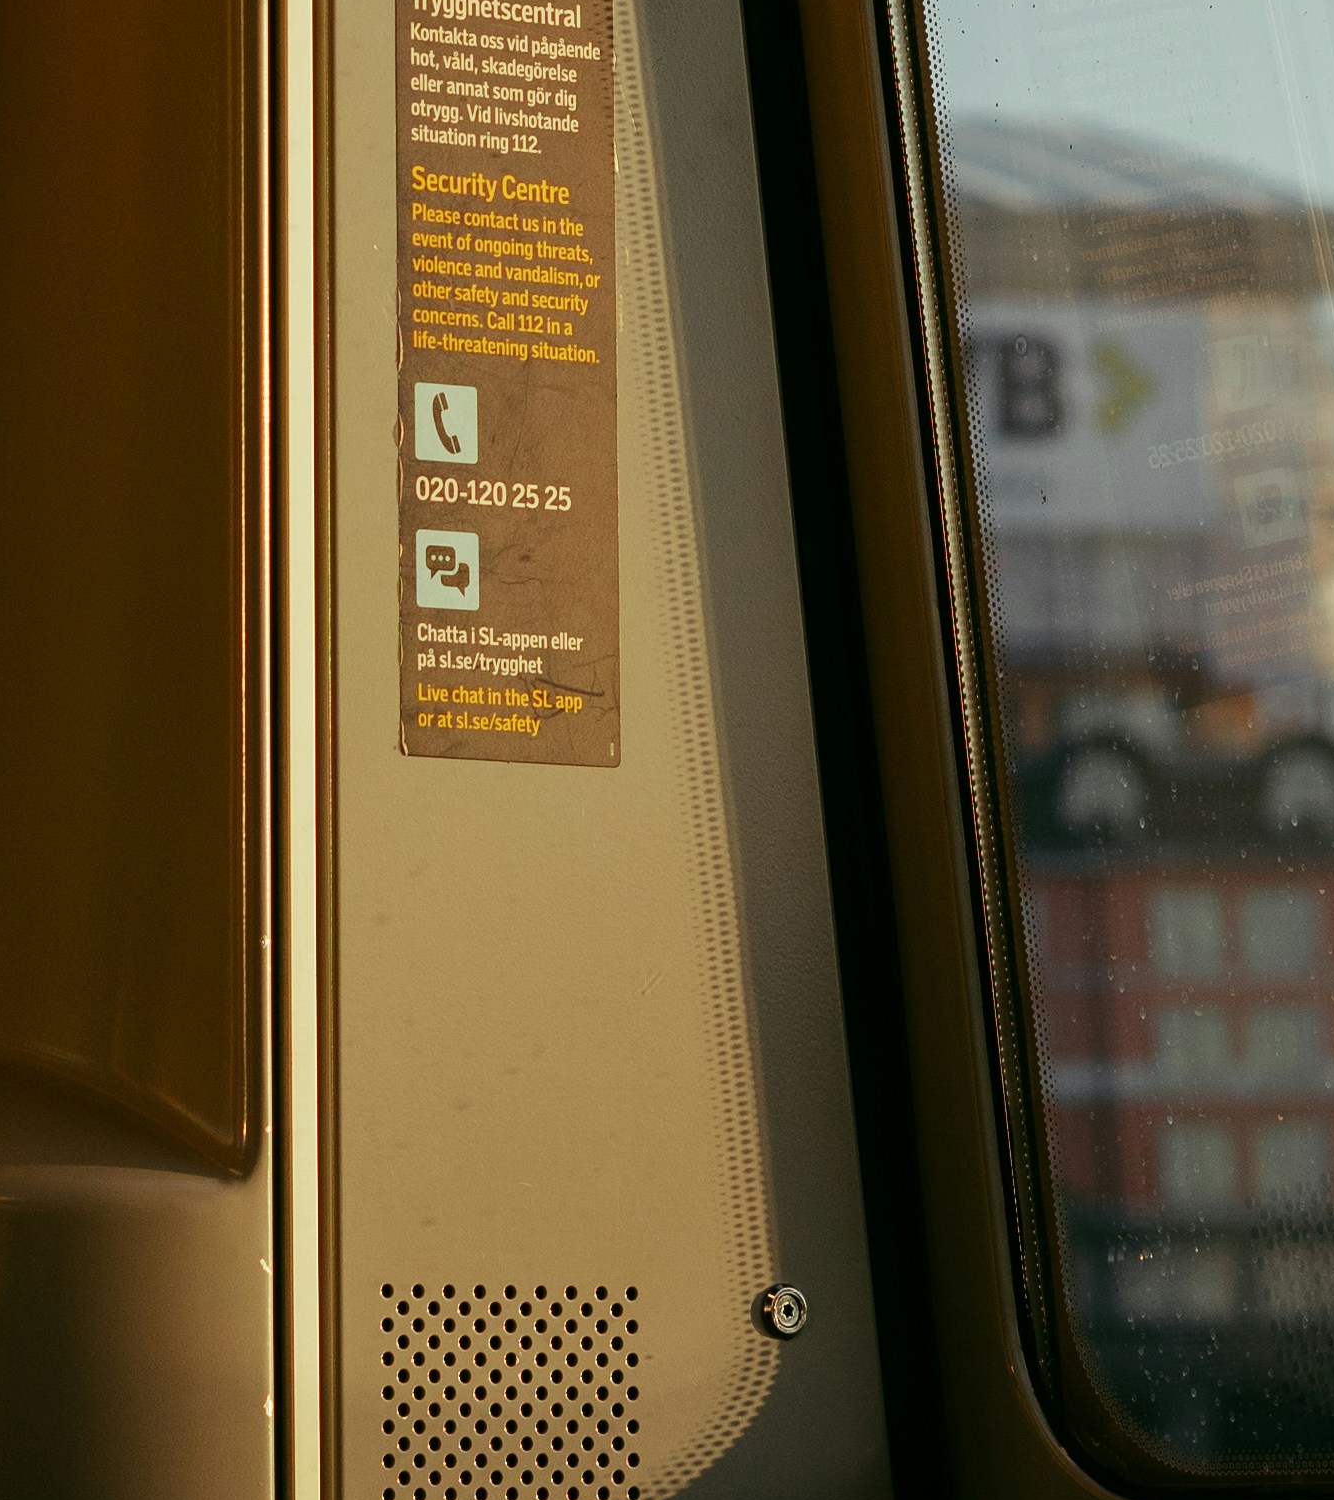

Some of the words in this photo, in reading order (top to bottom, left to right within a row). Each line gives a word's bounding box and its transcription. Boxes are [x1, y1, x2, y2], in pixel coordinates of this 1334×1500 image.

[409, 21, 478, 48] Kontakta
[479, 34, 505, 51] oss
[506, 34, 529, 53] vid
[531, 35, 602, 61] pågående
[410, 46, 440, 71] hot,
[442, 50, 479, 76] våld,
[481, 55, 578, 84] skadegörelse
[410, 72, 444, 94] eller
[445, 80, 490, 99] annat
[492, 85, 524, 103] som
[526, 86, 553, 108] gör
[554, 88, 578, 112] dig
[410, 98, 464, 125] otrygg.
[466, 103, 492, 124] Vid
[494, 106, 580, 134] livshotande
[410, 123, 477, 148] situation
[479, 131, 510, 155] ring
[511, 133, 543, 155] 112.
[411, 164, 498, 203] Security
[501, 174, 570, 206] Centre
[411, 201, 461, 226] Please
[463, 210, 520, 231] contact
[521, 217, 540, 233] us
[542, 215, 557, 234] in
[558, 216, 585, 237] the
[411, 231, 454, 250] event
[456, 232, 472, 252] of
[474, 237, 534, 261] ongoing
[535, 240, 594, 266] threats,
[411, 254, 472, 277] violence
[474, 261, 503, 280] and
[504, 265, 584, 290] vandalism,
[584, 273, 602, 289] or
[412, 279, 453, 301] other
[454, 283, 500, 309] safety
[501, 288, 529, 307] and
[531, 293, 589, 317] security
[412, 308, 484, 329] concerns.
[486, 310, 515, 331] Call
[517, 313, 545, 334] 112
[546, 316, 561, 336] in
[563, 321, 574, 337] a
[412, 329, 529, 361] life-threatening
[531, 340, 601, 364] situation.
[415, 475, 507, 507] 020-120
[511, 482, 540, 510] 25
[544, 484, 572, 512] 25
[416, 622, 468, 644] Chatta
[470, 626, 476, 645] i
[478, 626, 548, 652] SL-appen
[550, 631, 585, 652] eller
[416, 647, 437, 672] på
[438, 649, 544, 677] sl.se/trygghet
[417, 681, 449, 703] Live
[451, 684, 485, 705] chat
[487, 686, 502, 706] in
[504, 687, 530, 708] the
[531, 689, 553, 709] SL
[555, 694, 583, 715] app
[417, 712, 435, 728] or
[436, 710, 453, 729] at
[455, 710, 541, 738] sl.se/safety
